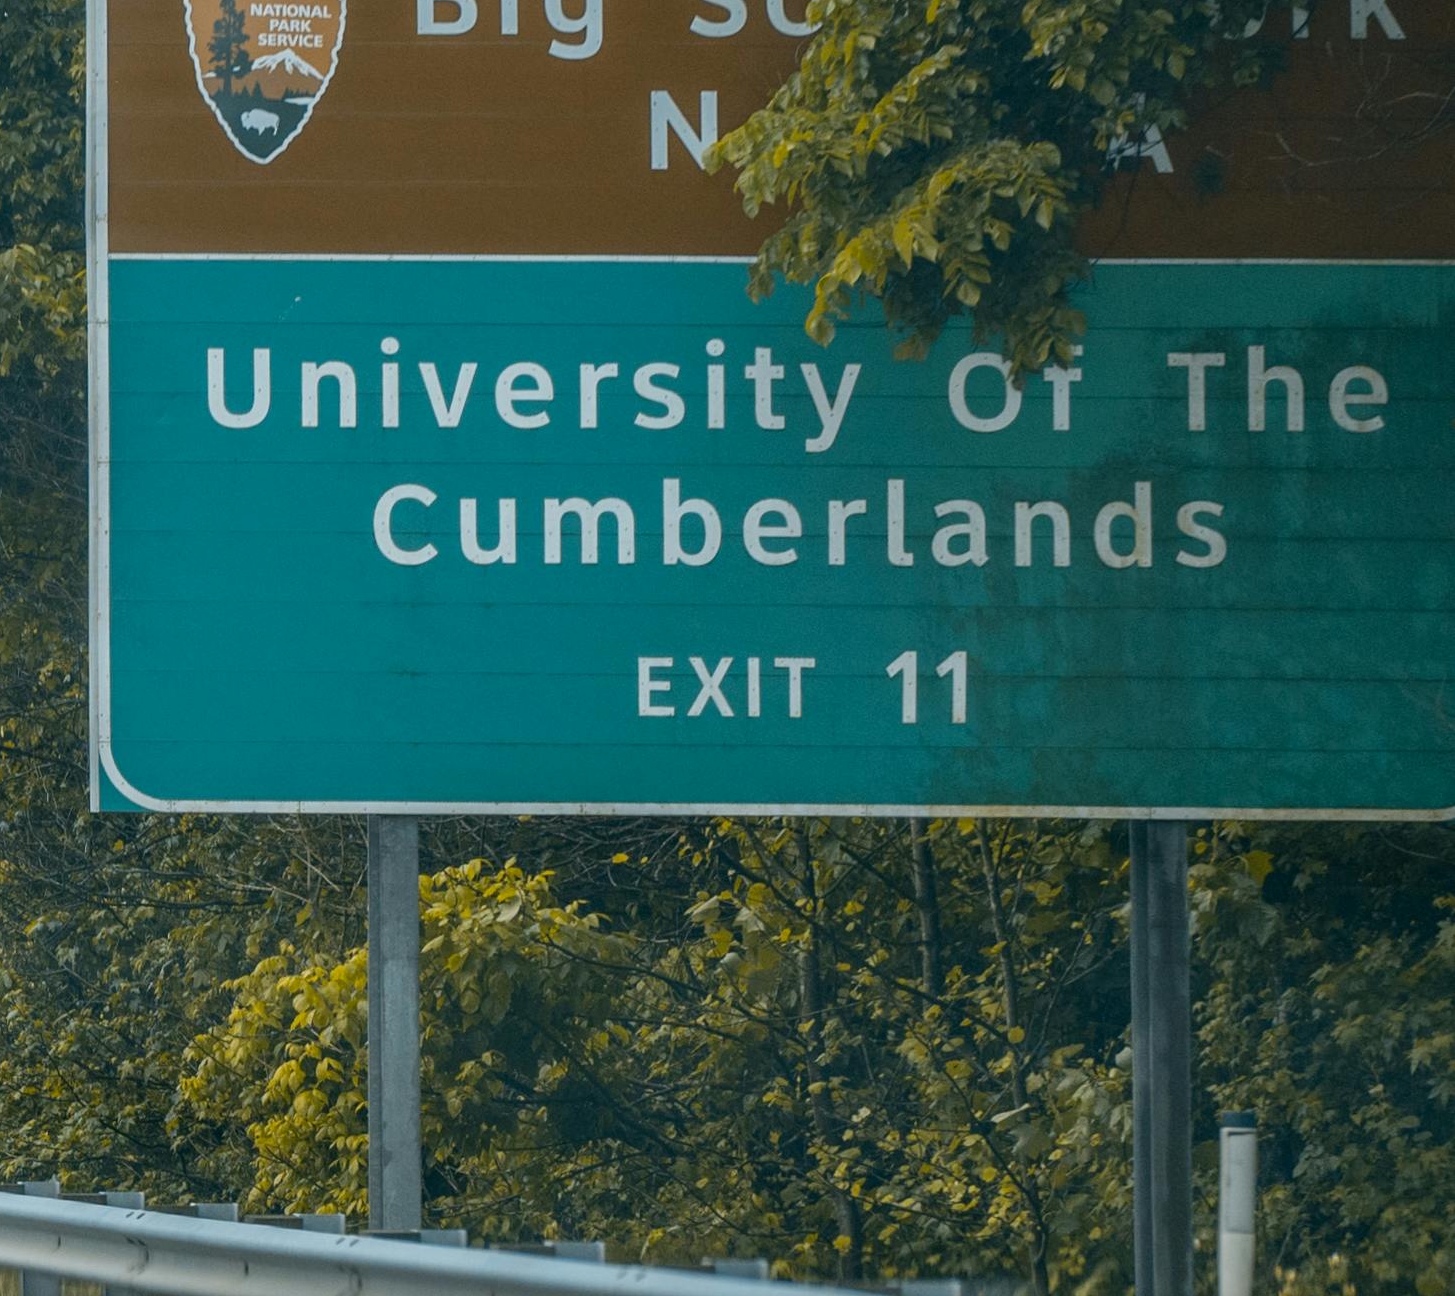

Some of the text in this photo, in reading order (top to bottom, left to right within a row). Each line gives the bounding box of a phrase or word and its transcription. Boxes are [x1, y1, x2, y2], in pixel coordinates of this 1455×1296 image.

[250, 3, 332, 18] NATIONAL
[269, 19, 312, 32] PARK
[258, 34, 324, 48] SERVICE
[206, 336, 1389, 453] University Of The
[372, 478, 1228, 569] Cumberlands
[637, 650, 968, 724] EXIT 11
